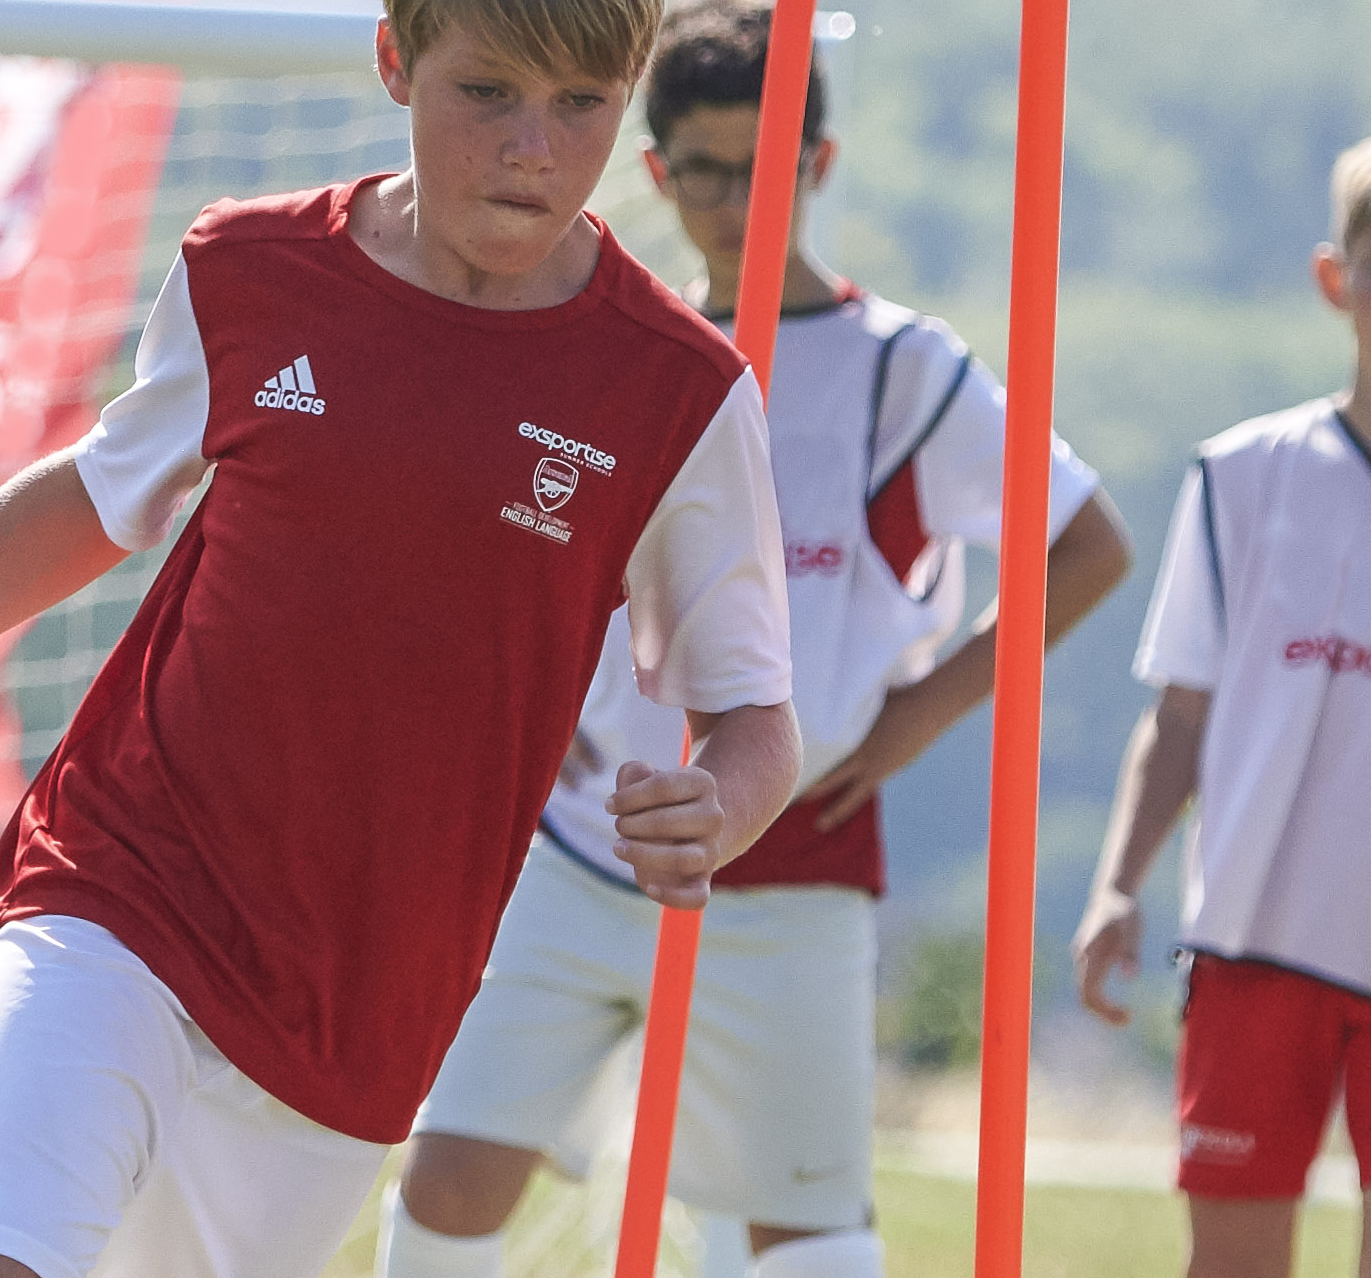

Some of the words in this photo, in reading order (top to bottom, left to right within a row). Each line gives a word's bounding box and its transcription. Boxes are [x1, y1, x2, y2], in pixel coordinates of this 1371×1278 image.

[254, 387, 326, 416] adidas
[518, 421, 617, 470] exsportise
[500, 506, 536, 528] ENGLISH
[535, 520, 573, 542] LANGUAGE
